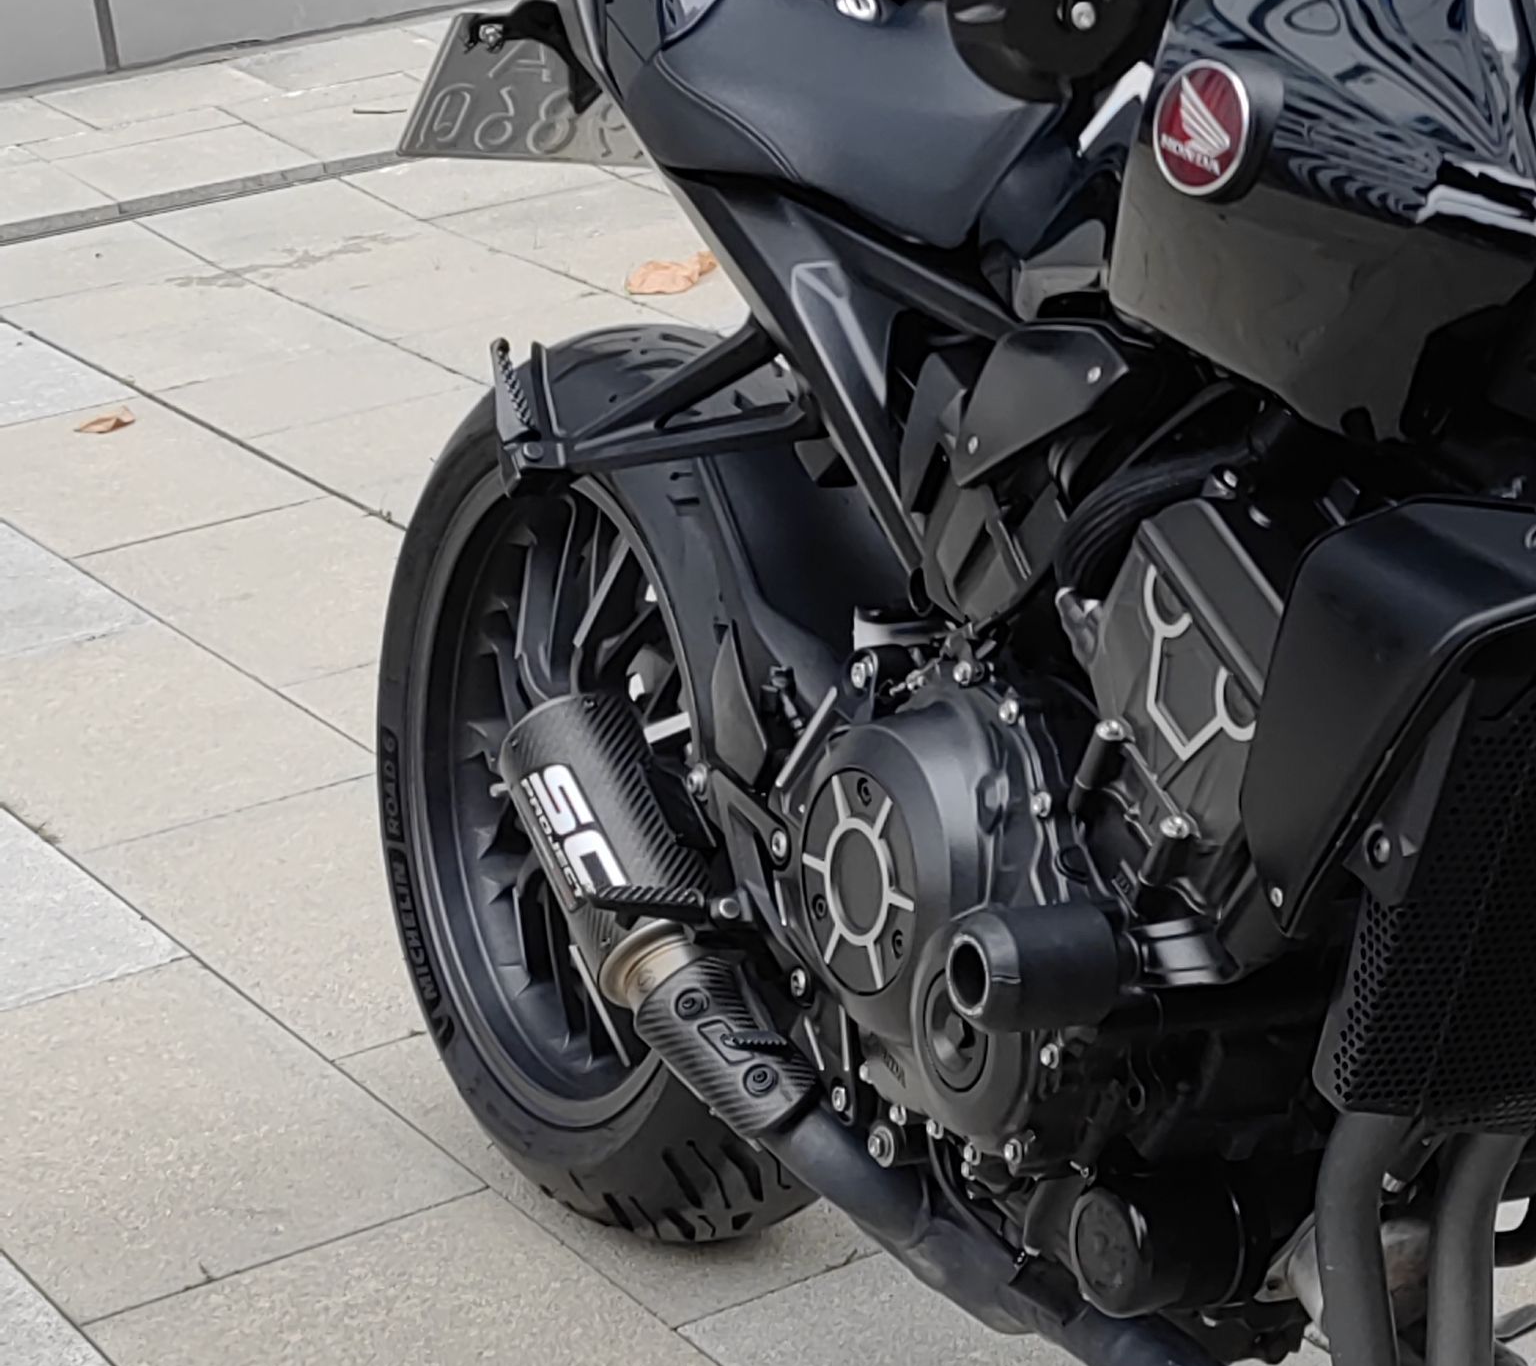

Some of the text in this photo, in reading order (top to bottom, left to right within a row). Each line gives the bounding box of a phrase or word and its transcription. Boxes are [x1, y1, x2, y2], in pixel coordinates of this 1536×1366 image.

[1160, 133, 1221, 177] HONDA
[383, 762, 400, 835] ROAD
[520, 777, 583, 897] PROJECT
[392, 861, 438, 1000] MICHELIN
